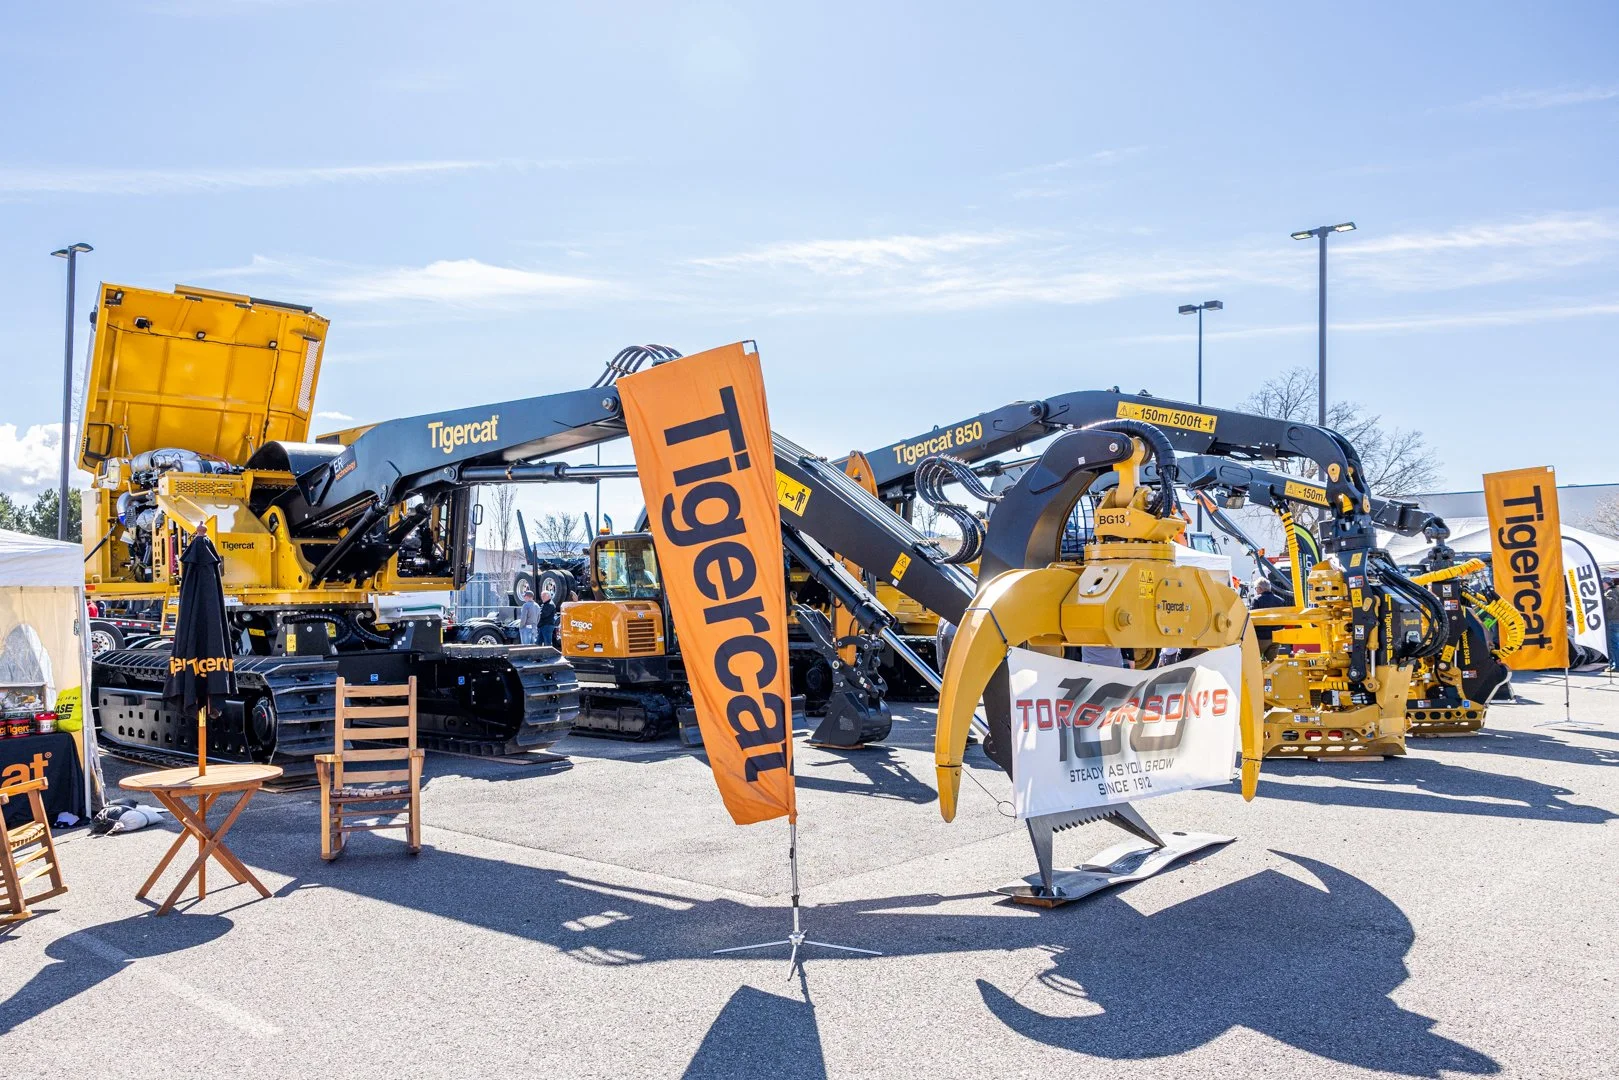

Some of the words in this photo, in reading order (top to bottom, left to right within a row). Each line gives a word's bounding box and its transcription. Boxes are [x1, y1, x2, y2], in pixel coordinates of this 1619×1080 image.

[428, 415, 499, 454] Tigercat
[892, 430, 953, 466] Tigercat
[955, 421, 983, 446] 850
[1099, 514, 1126, 525] BG13
[221, 541, 255, 551] Tigercat
[1498, 485, 1553, 650] Tigercat
[662, 386, 793, 782] Tigercat
[1161, 600, 1185, 614] Tigercat
[55, 703, 75, 715] ASE
[1057, 667, 1197, 762] 100
[1069, 766, 1105, 783] STEADY
[1108, 764, 1125, 778] AS
[1124, 761, 1142, 775] YOU
[1144, 758, 1175, 772] GROW
[1097, 779, 1130, 796] SINCE
[1133, 776, 1153, 791] 1912
